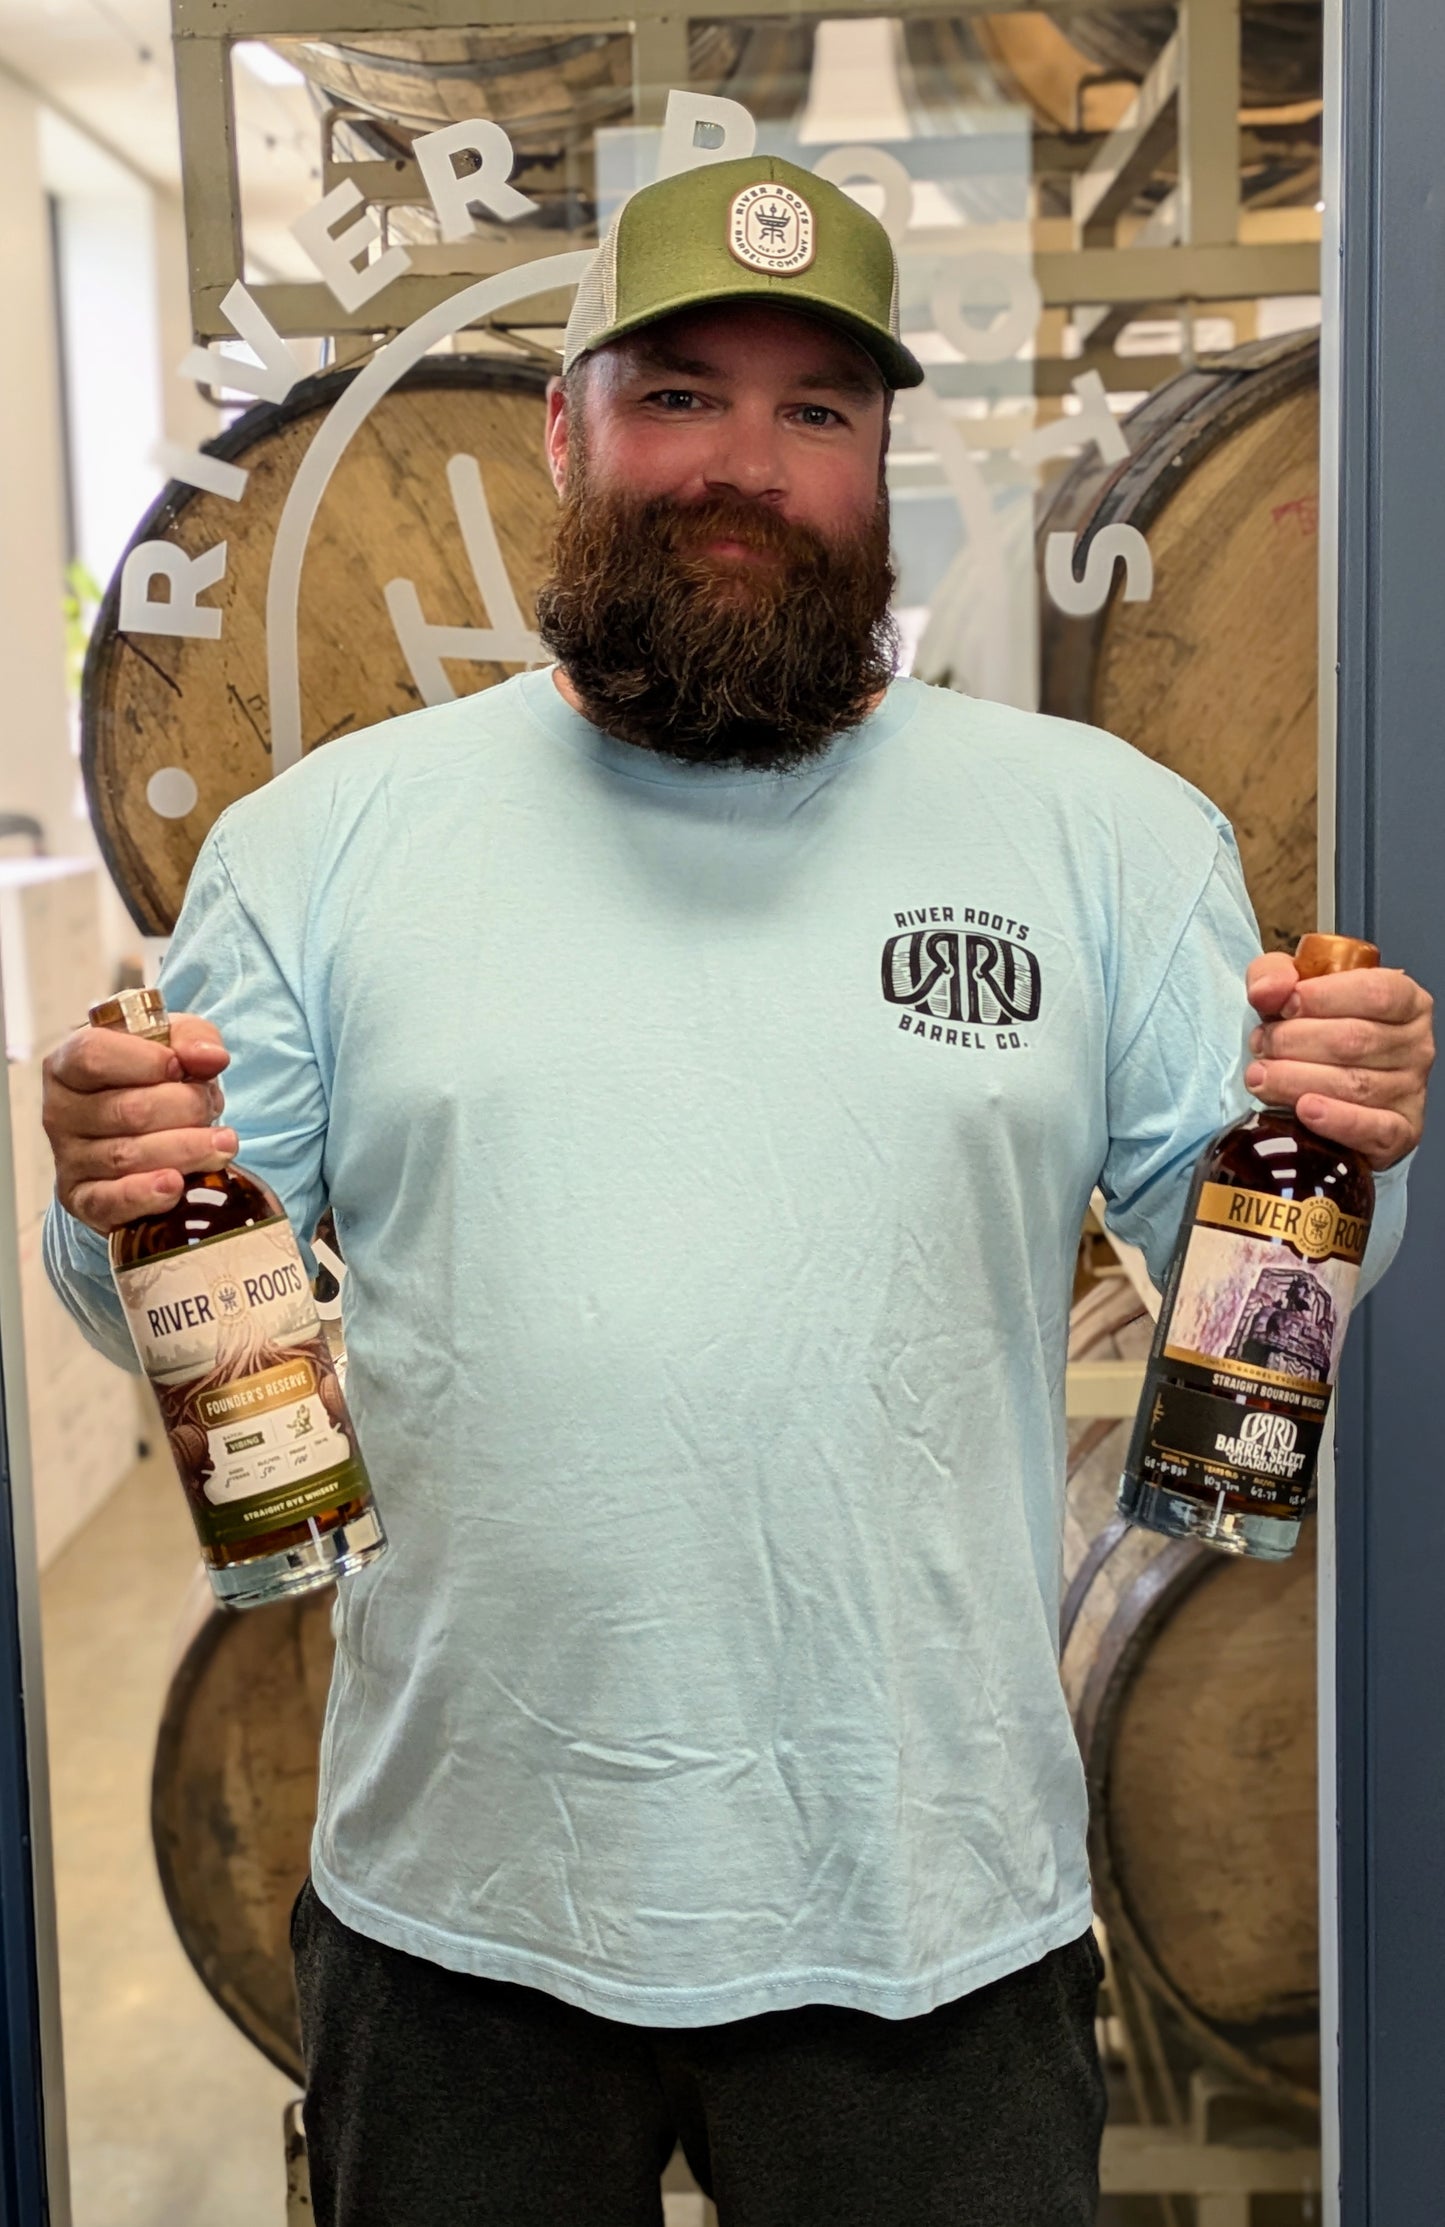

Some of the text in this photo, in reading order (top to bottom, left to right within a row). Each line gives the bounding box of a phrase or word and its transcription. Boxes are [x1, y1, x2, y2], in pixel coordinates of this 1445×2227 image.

[736, 187, 809, 225] RIVER ROOTS
[735, 230, 808, 268] BARREL COMPANY
[117, 118, 539, 640] RIVER
[894, 907, 1030, 941] RIVER ROOTS
[899, 1014, 1028, 1050] BARREL CO.
[1228, 1193, 1302, 1235] RIVER
[147, 1294, 215, 1338] RIVER
[243, 1263, 302, 1308] ROOTS
[206, 1371, 308, 1417] FOUNDER'S RESERVE
[1212, 1373, 1259, 1395] STRAIGHT
[1260, 1385, 1301, 1406] BOURBON
[1214, 1434, 1306, 1470] BARREL SELECT
[243, 1481, 339, 1522] STRAIGHT RYE WHISKEY
